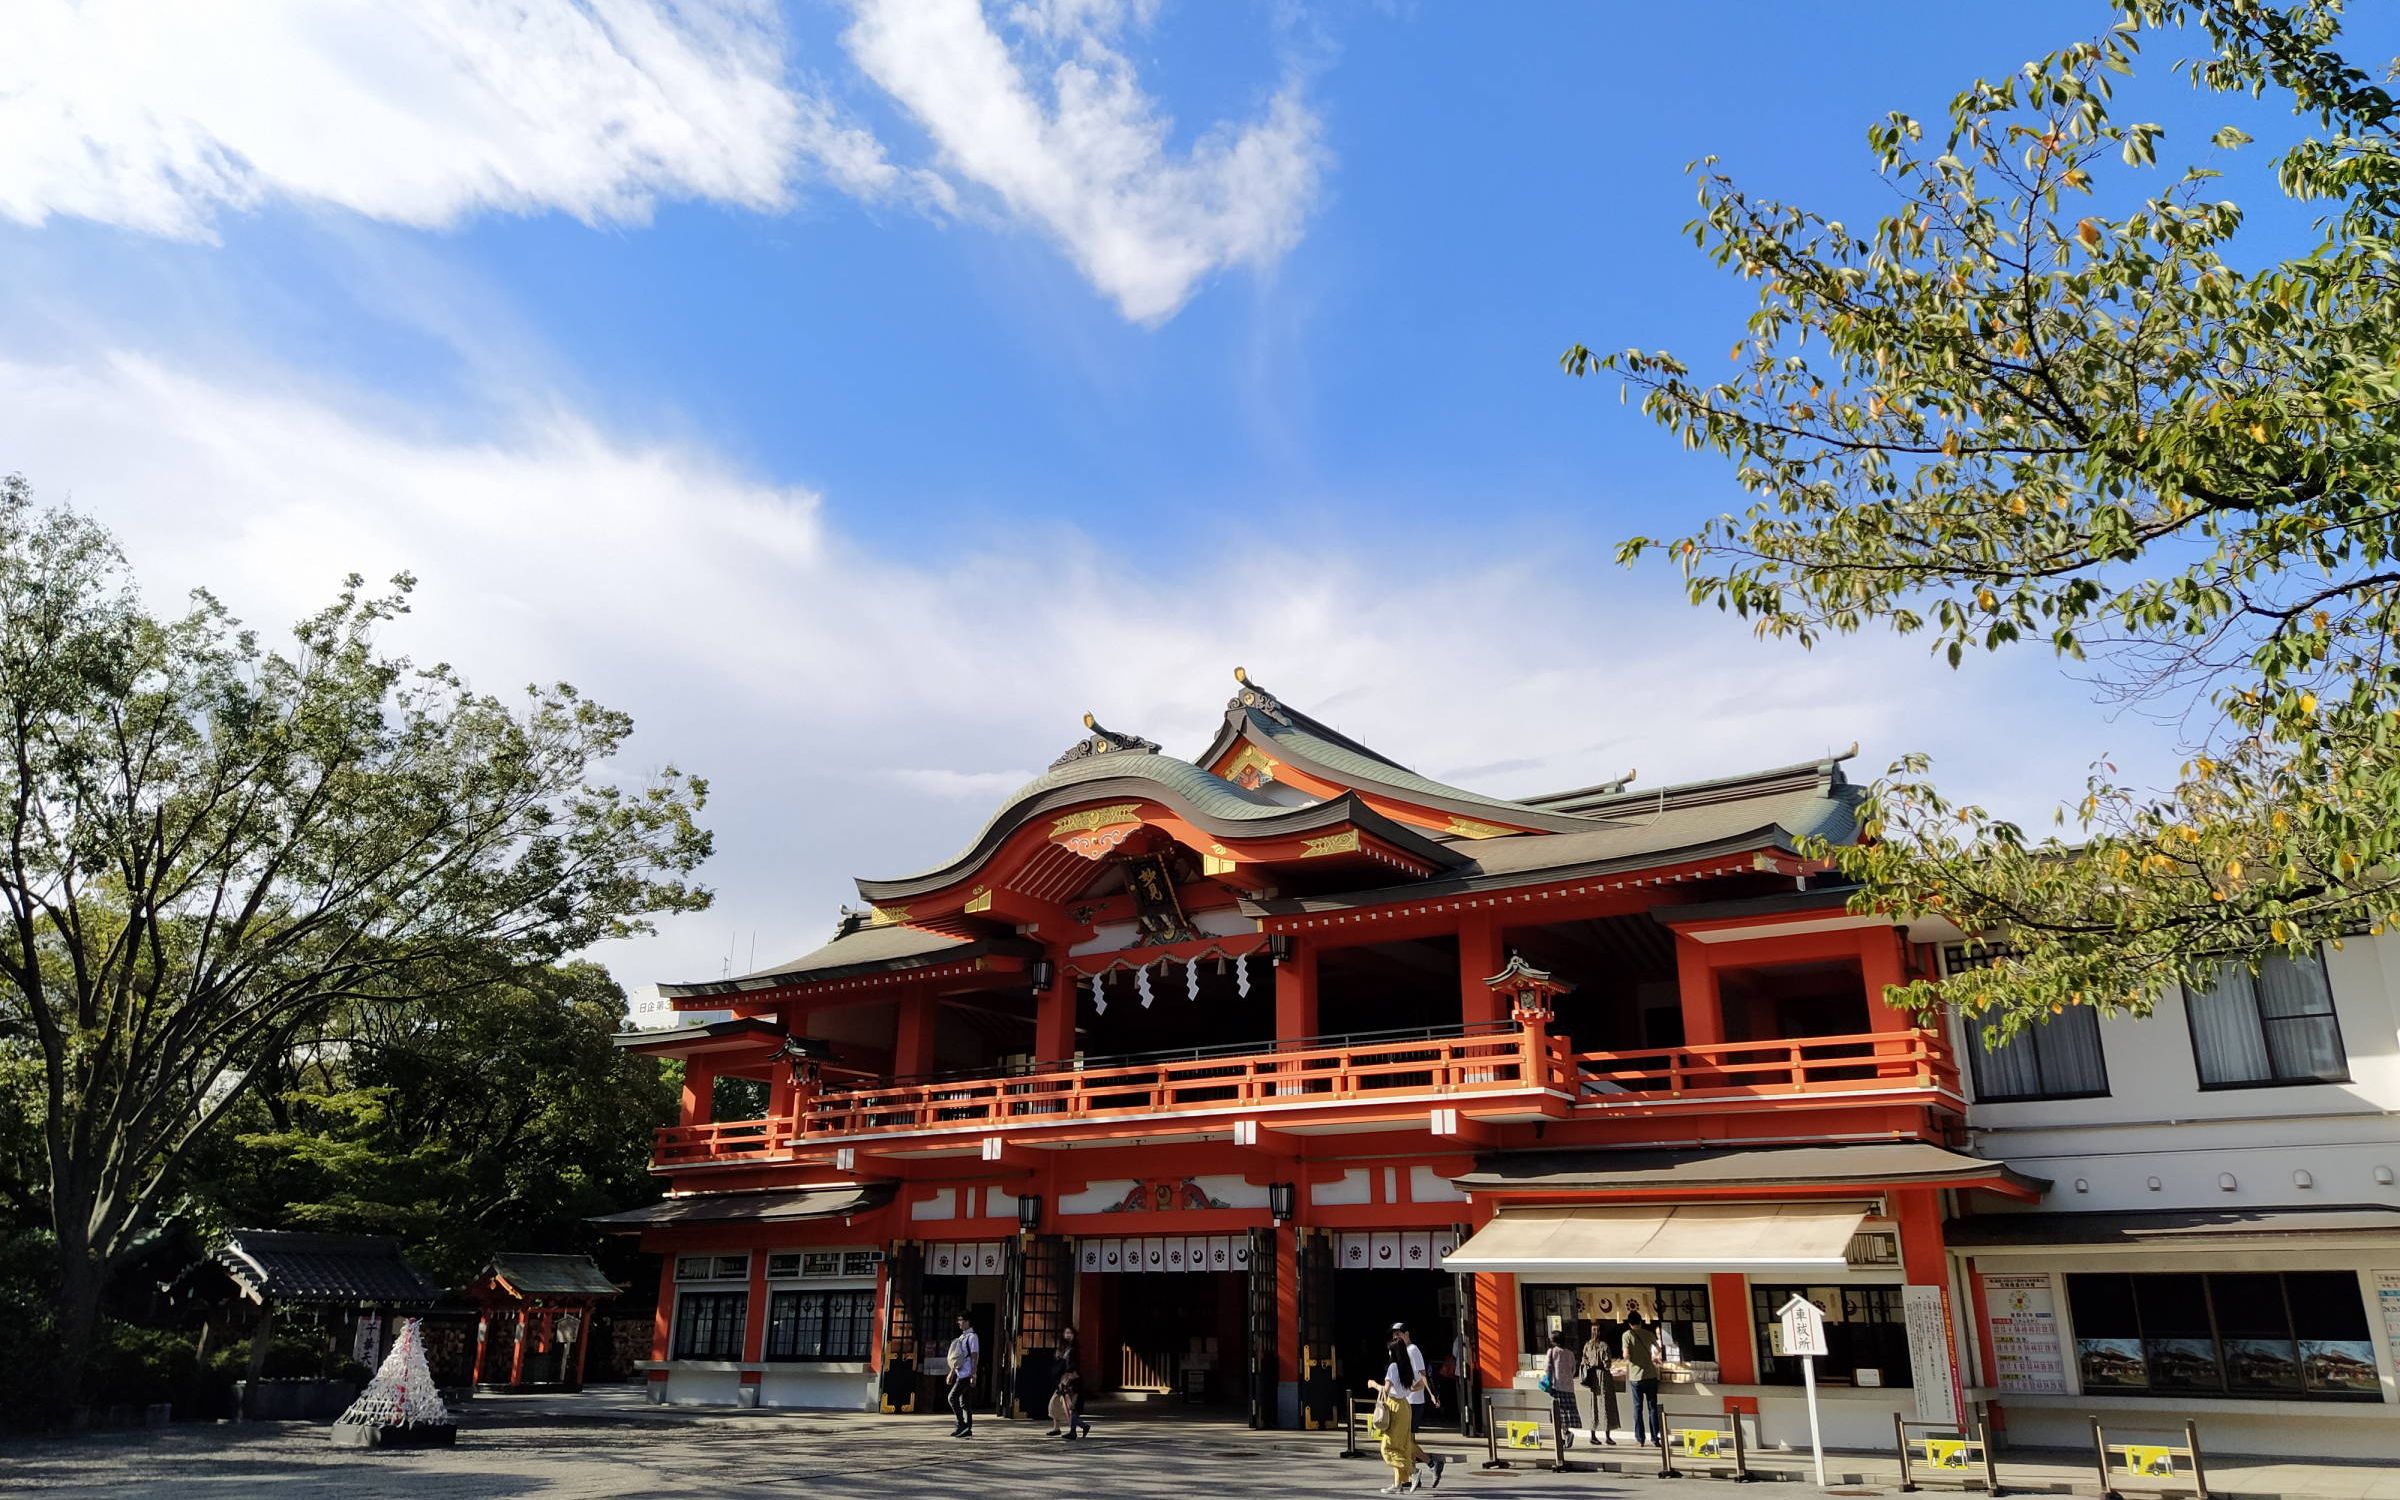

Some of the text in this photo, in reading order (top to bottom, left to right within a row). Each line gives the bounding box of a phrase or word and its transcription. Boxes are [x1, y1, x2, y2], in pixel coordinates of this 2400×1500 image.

[1138, 867, 1163, 901] 妙見
[361, 1322, 378, 1368] 千葉天
[1793, 1307, 1811, 1351] 車祓所
